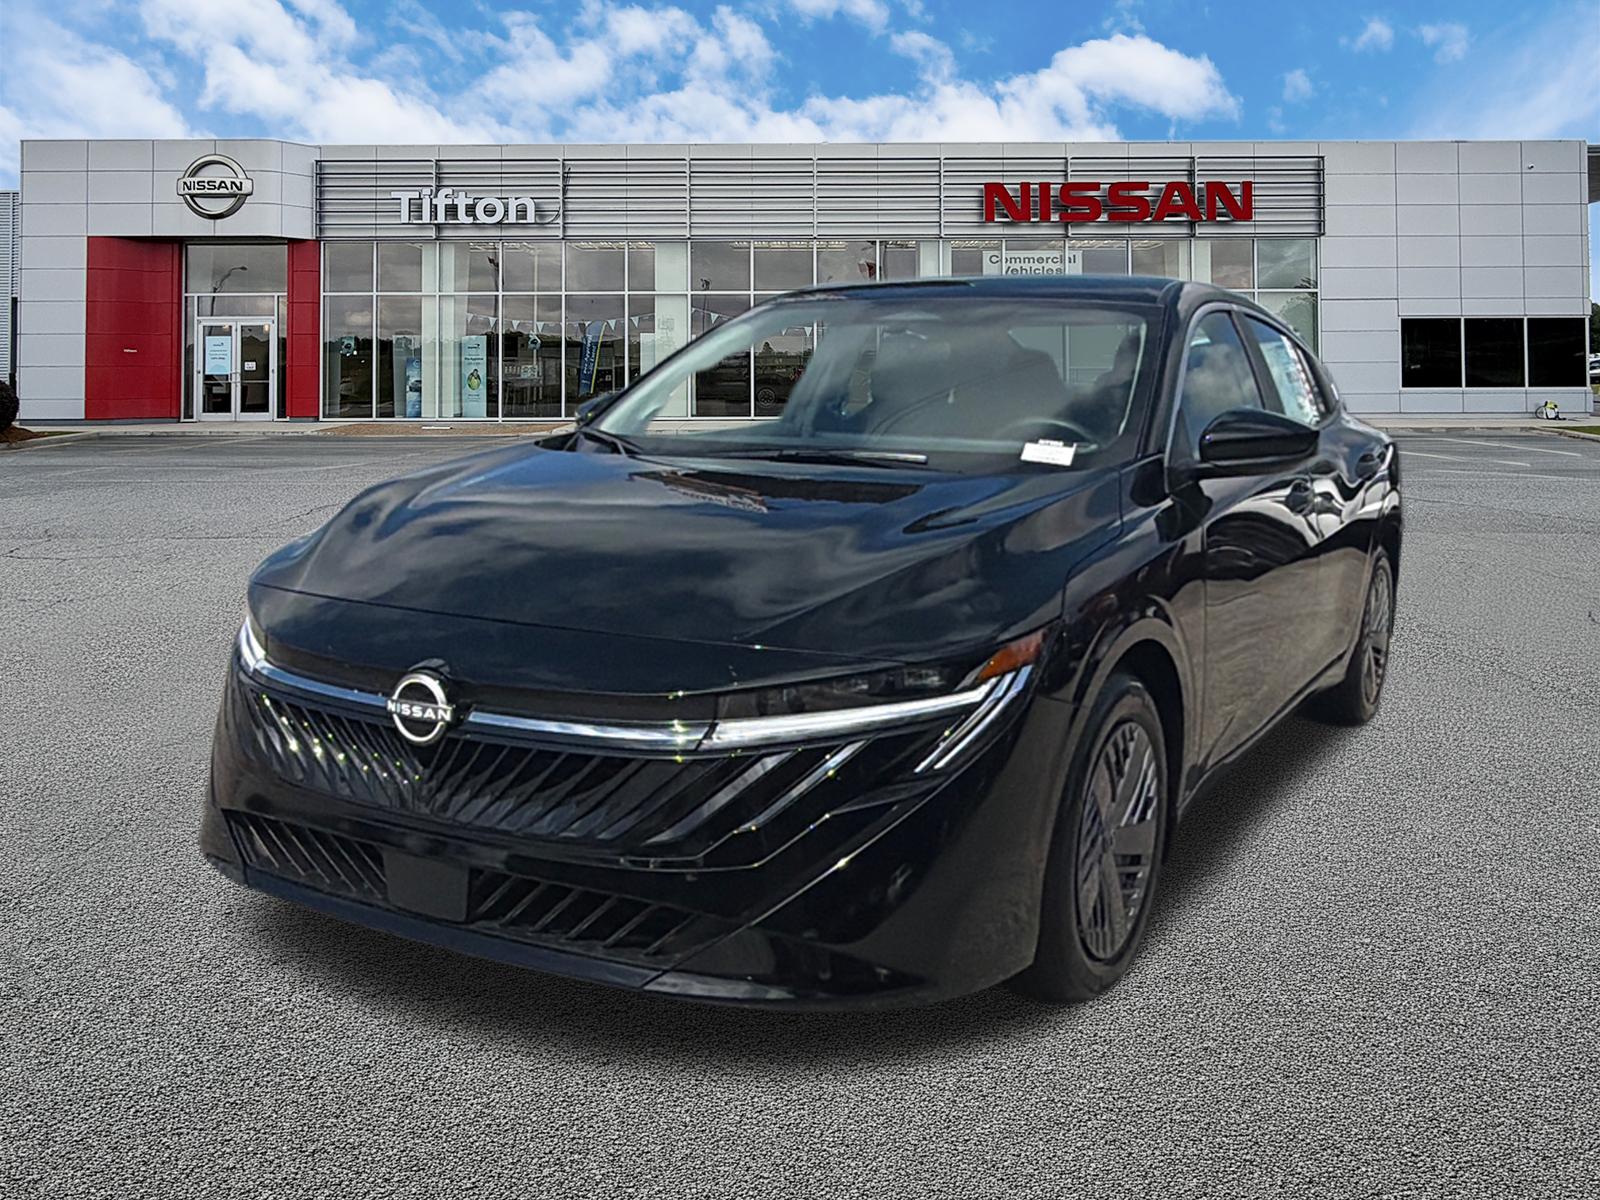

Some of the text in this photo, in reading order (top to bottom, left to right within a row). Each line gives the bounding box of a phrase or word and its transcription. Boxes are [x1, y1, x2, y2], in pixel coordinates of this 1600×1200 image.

[182, 180, 243, 191] NISSAN
[391, 188, 536, 224] Tifton
[984, 181, 1253, 222] NISSAN
[387, 700, 452, 721] NISSAN
